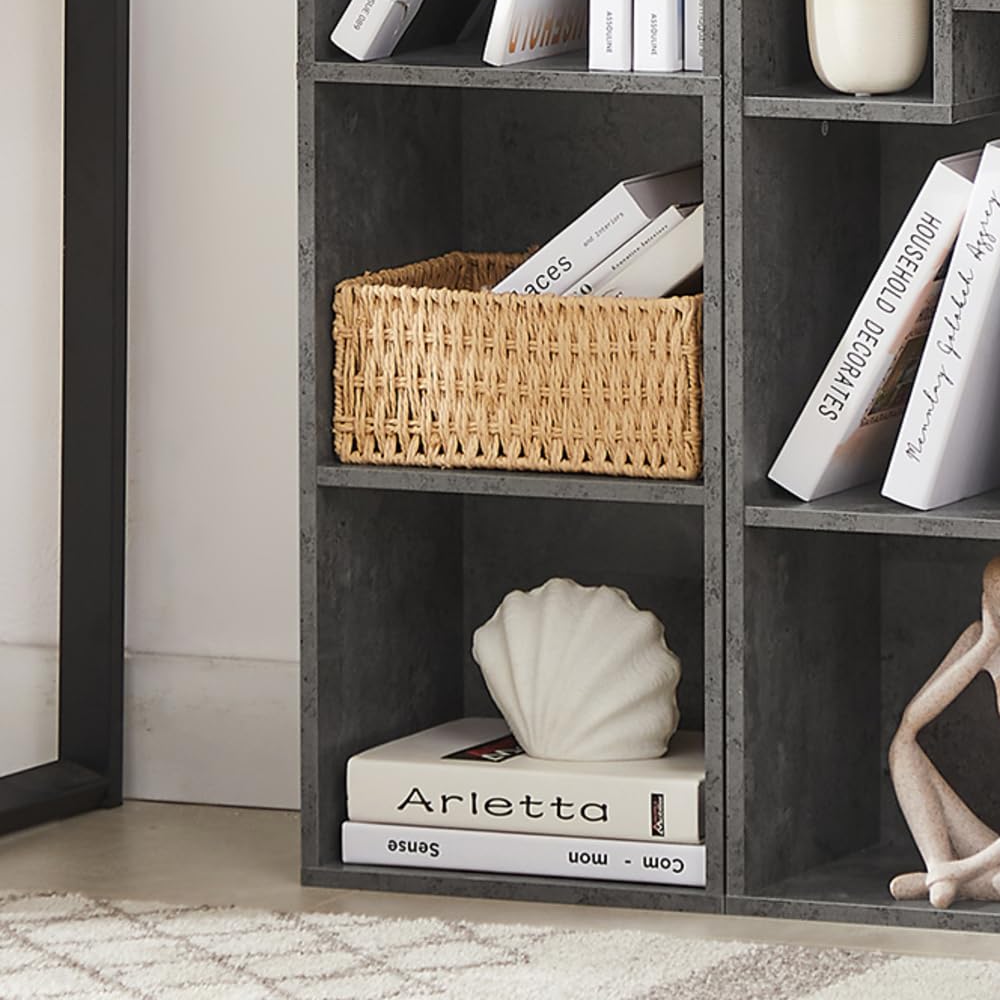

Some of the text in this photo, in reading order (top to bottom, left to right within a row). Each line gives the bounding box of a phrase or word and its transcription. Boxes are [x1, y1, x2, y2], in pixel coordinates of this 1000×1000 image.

[818, 211, 942, 422] HOUSEHOLD DECORATES
[397, 787, 609, 822] Arletta
[387, 839, 440, 857] Sense
[569, 851, 608, 866] mon
[643, 857, 685, 873] Com
